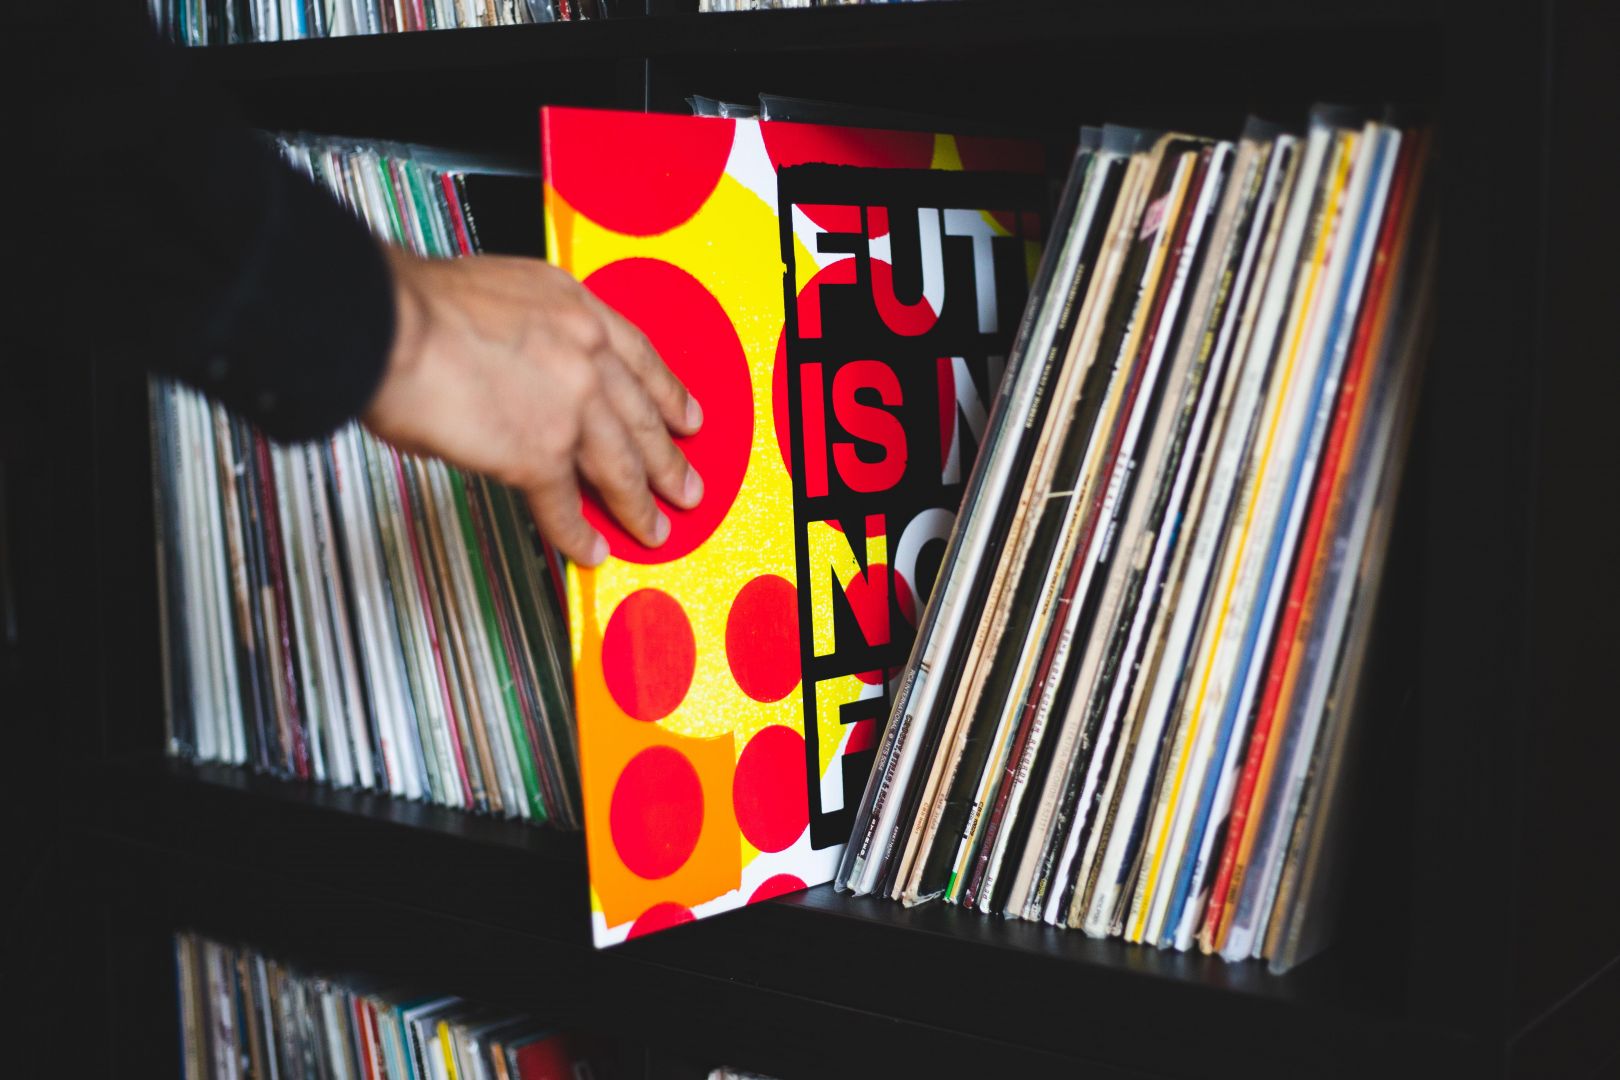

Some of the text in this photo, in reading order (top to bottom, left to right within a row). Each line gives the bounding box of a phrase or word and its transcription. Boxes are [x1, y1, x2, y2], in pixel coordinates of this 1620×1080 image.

[791, 203, 1044, 339] FUT
[800, 359, 908, 498] IS
[905, 667, 915, 683] RCA
[889, 681, 911, 730] INTERNATIONAL
[883, 750, 901, 783] STILLS
[975, 800, 984, 817] CBS
